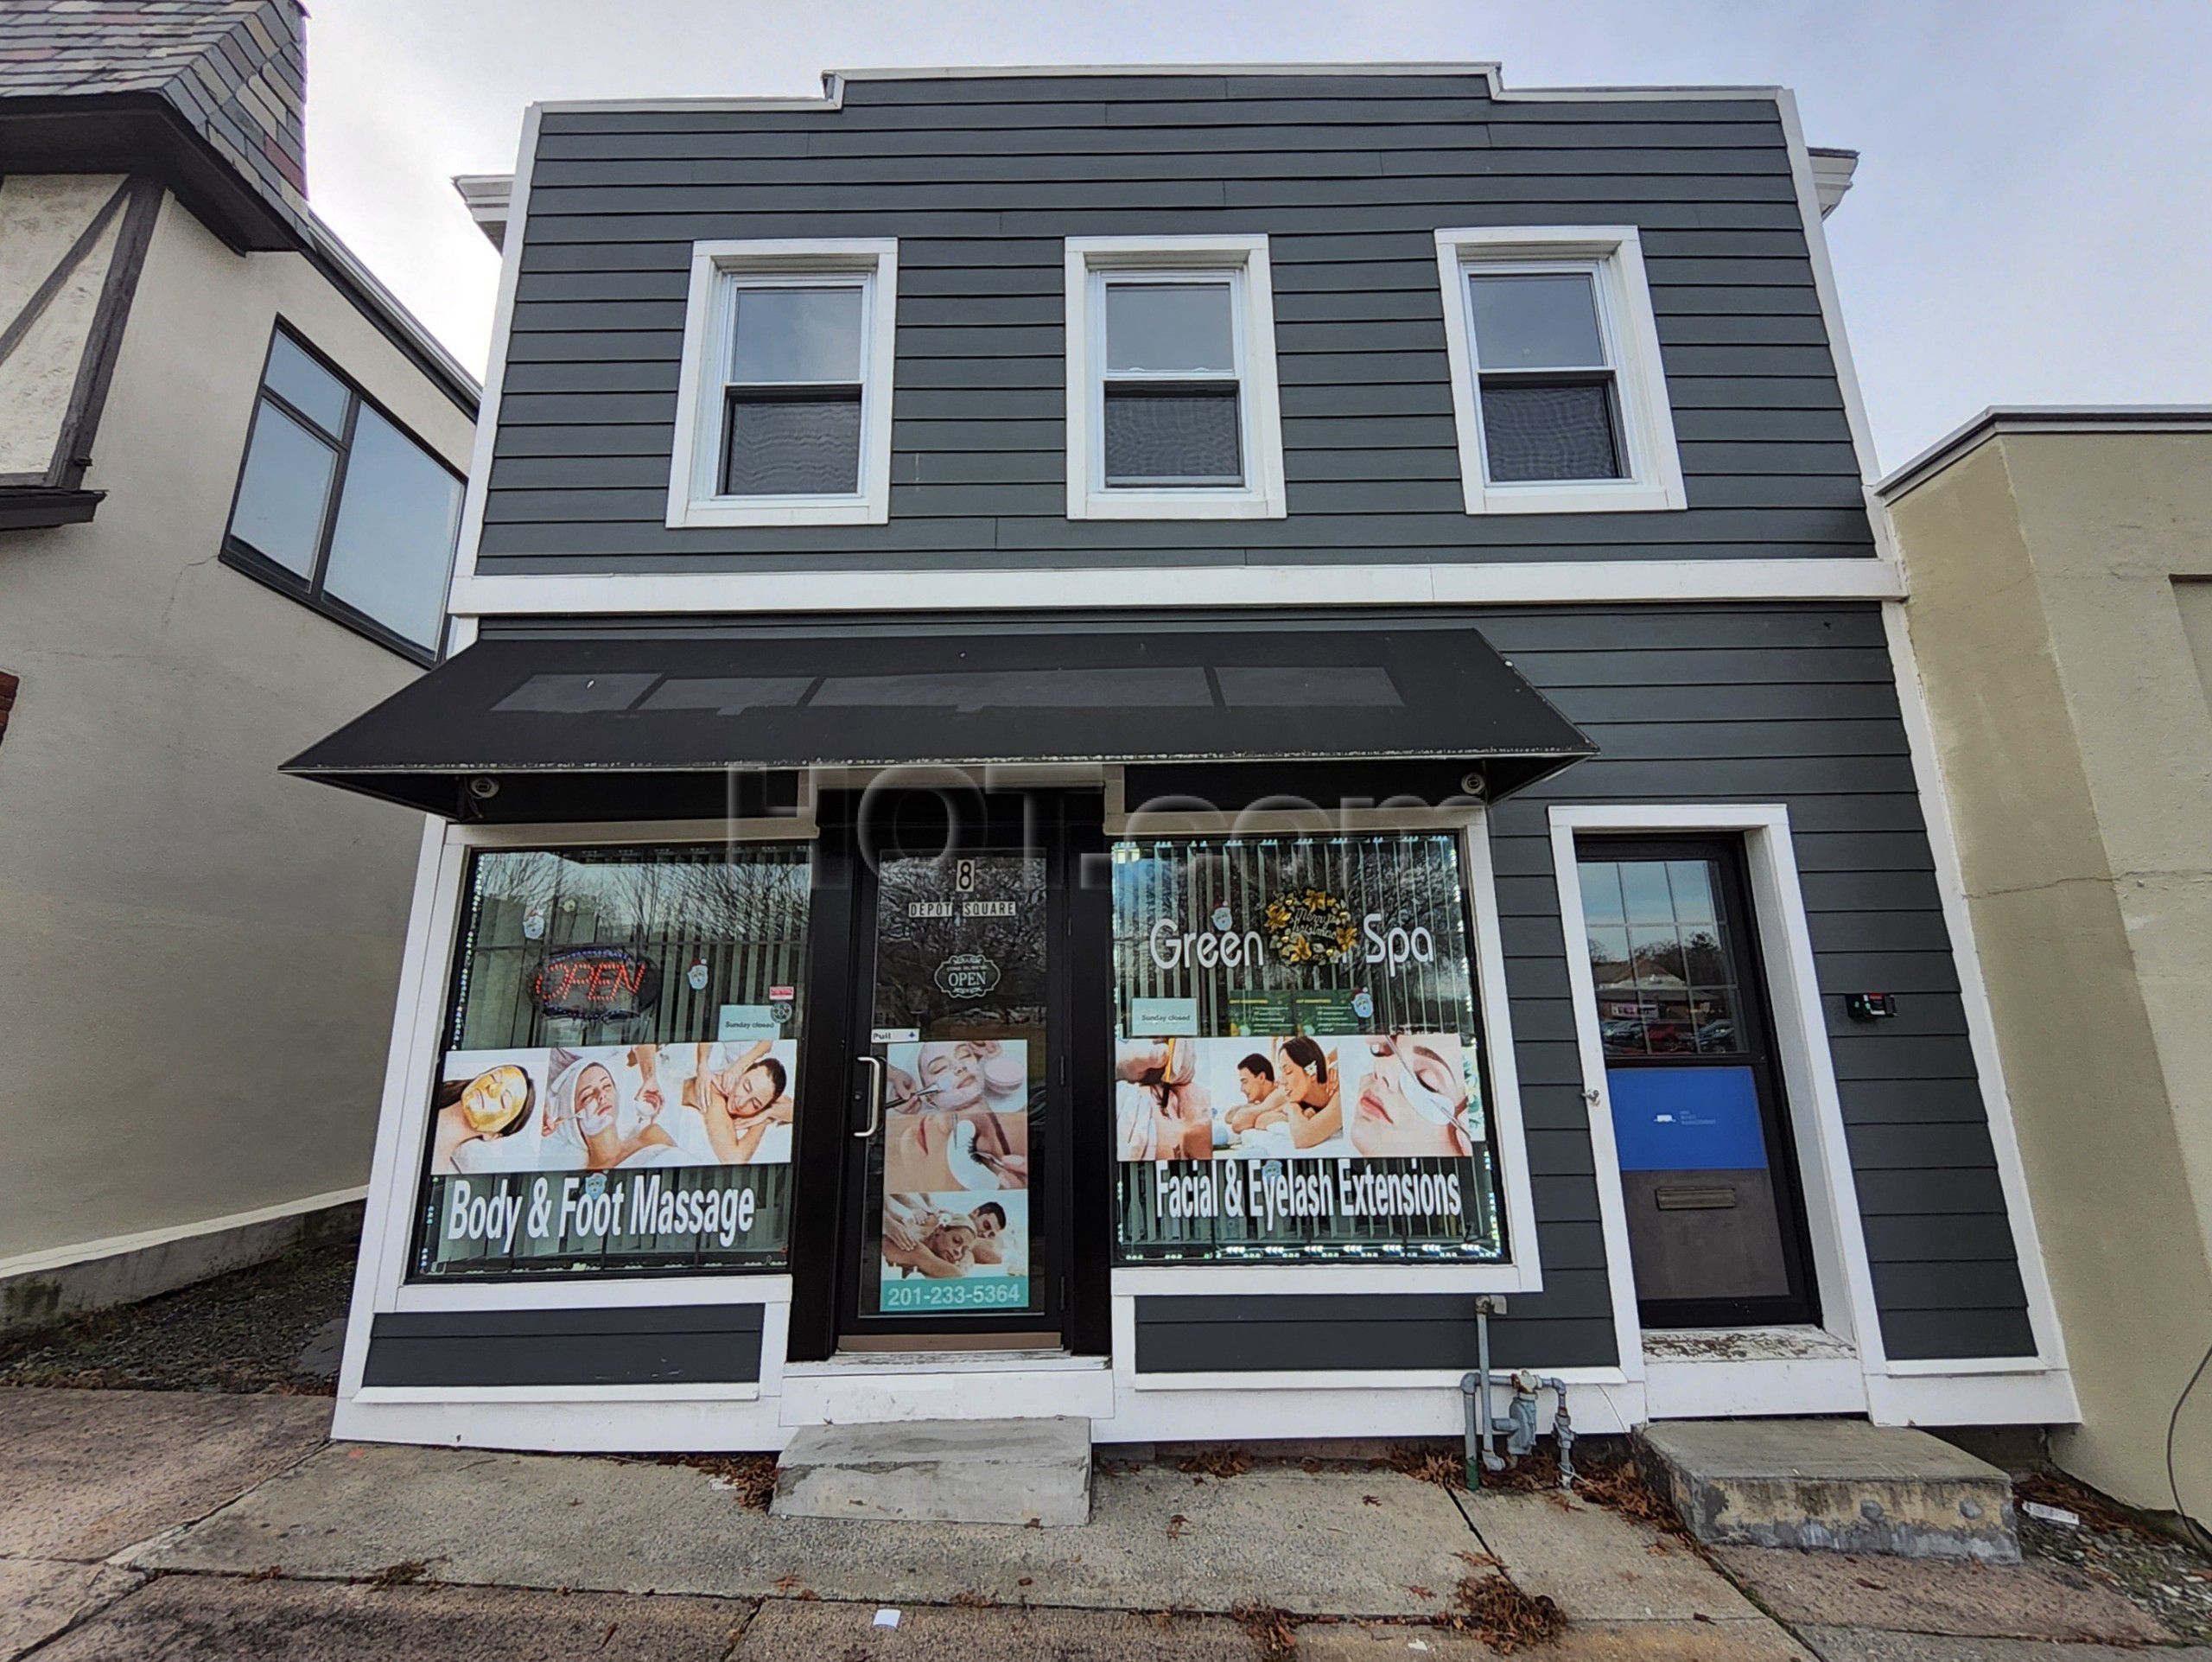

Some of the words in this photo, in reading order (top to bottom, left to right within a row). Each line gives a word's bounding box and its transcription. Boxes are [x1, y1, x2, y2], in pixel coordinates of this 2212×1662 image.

[958, 861, 972, 889] 8
[910, 902, 951, 917] DEPOT
[964, 901, 1014, 916] SQUARE
[1150, 918, 1264, 970] Green
[1363, 914, 1433, 977] Spa
[535, 960, 647, 1003] OPEN
[948, 971, 986, 987] OPEN
[726, 1021, 750, 1029] Sunday
[1156, 1160, 1218, 1217] Facial
[1225, 1161, 1244, 1217] &
[1249, 1160, 1334, 1230] Eyelash
[1340, 1159, 1461, 1217] Extensions
[448, 1178, 522, 1252] Body
[528, 1182, 551, 1237] &
[559, 1174, 625, 1237] Foot
[631, 1174, 754, 1247] Massage
[888, 1283, 1020, 1306] 201-233-5364
